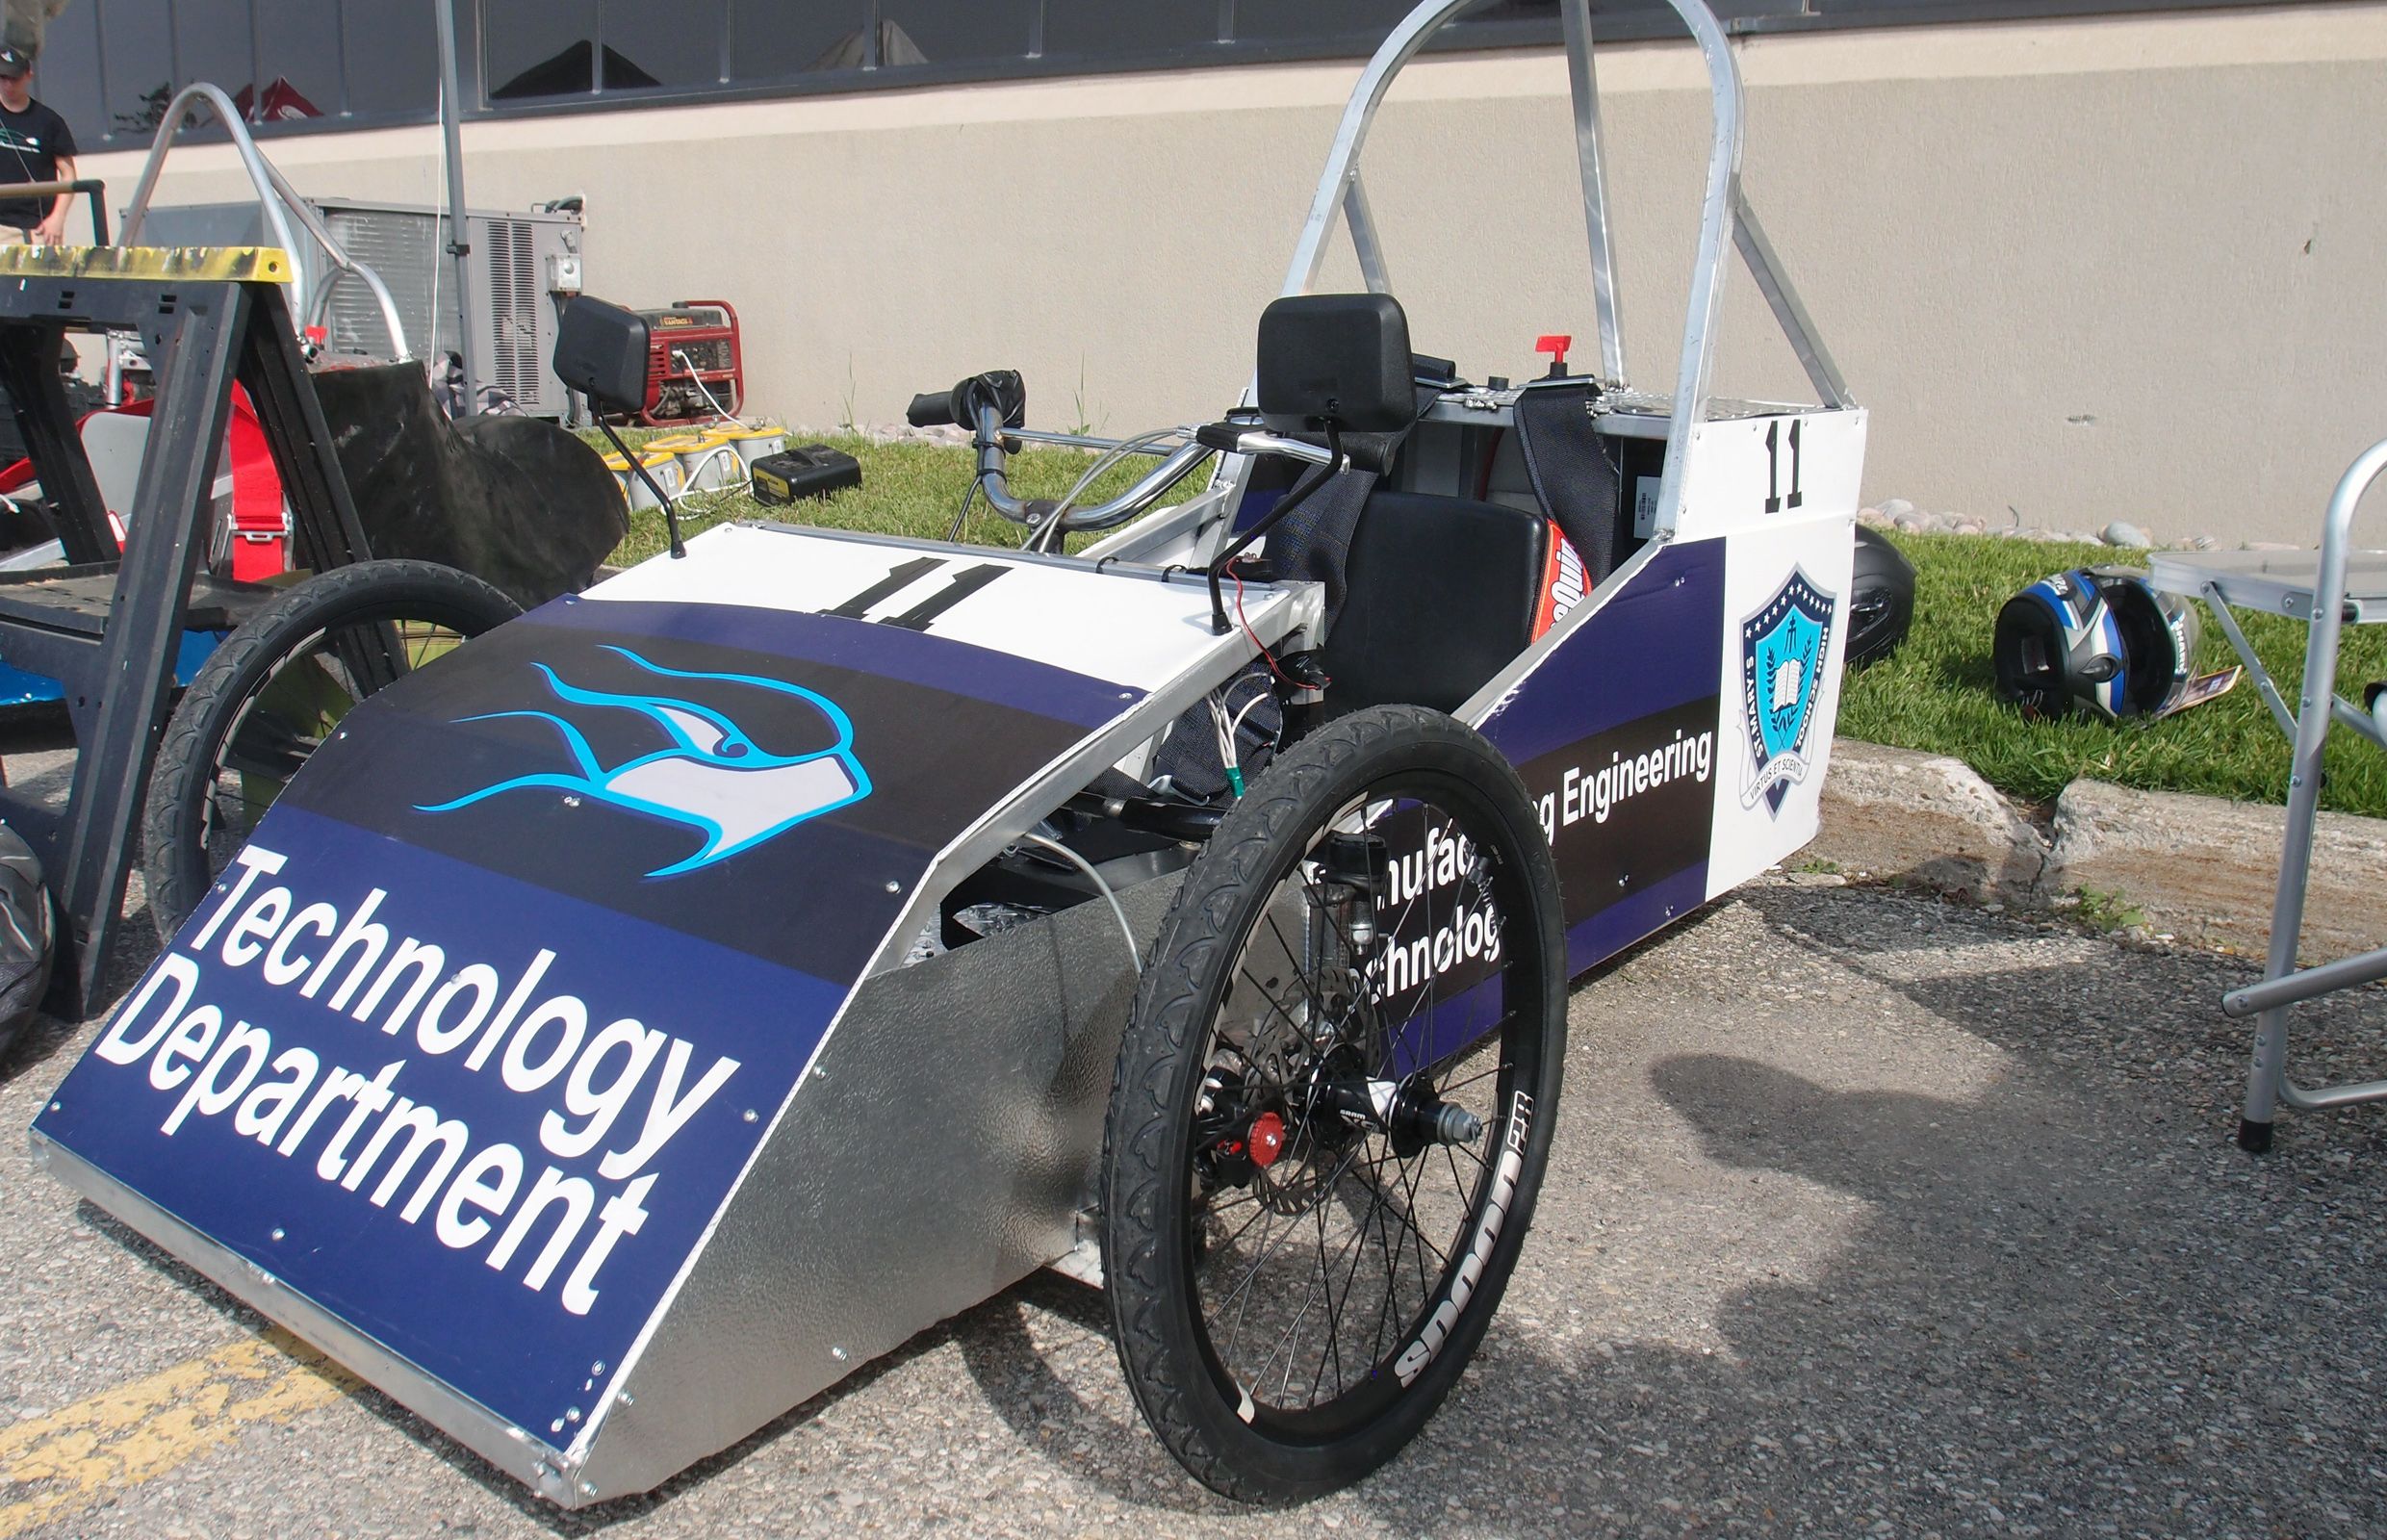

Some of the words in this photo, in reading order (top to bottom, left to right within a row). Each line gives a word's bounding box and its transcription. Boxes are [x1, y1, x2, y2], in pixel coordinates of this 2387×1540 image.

[1764, 420, 1802, 514] 11
[815, 556, 1014, 632] 11
[1815, 627, 1829, 674] HIGH
[1795, 678, 1818, 748] SCHOOL
[1562, 729, 1711, 826] Engineering
[1750, 767, 1773, 800] VIRTUS
[1773, 760, 1782, 775] ET
[191, 844, 740, 1180] Technology
[94, 952, 658, 1316] Department
